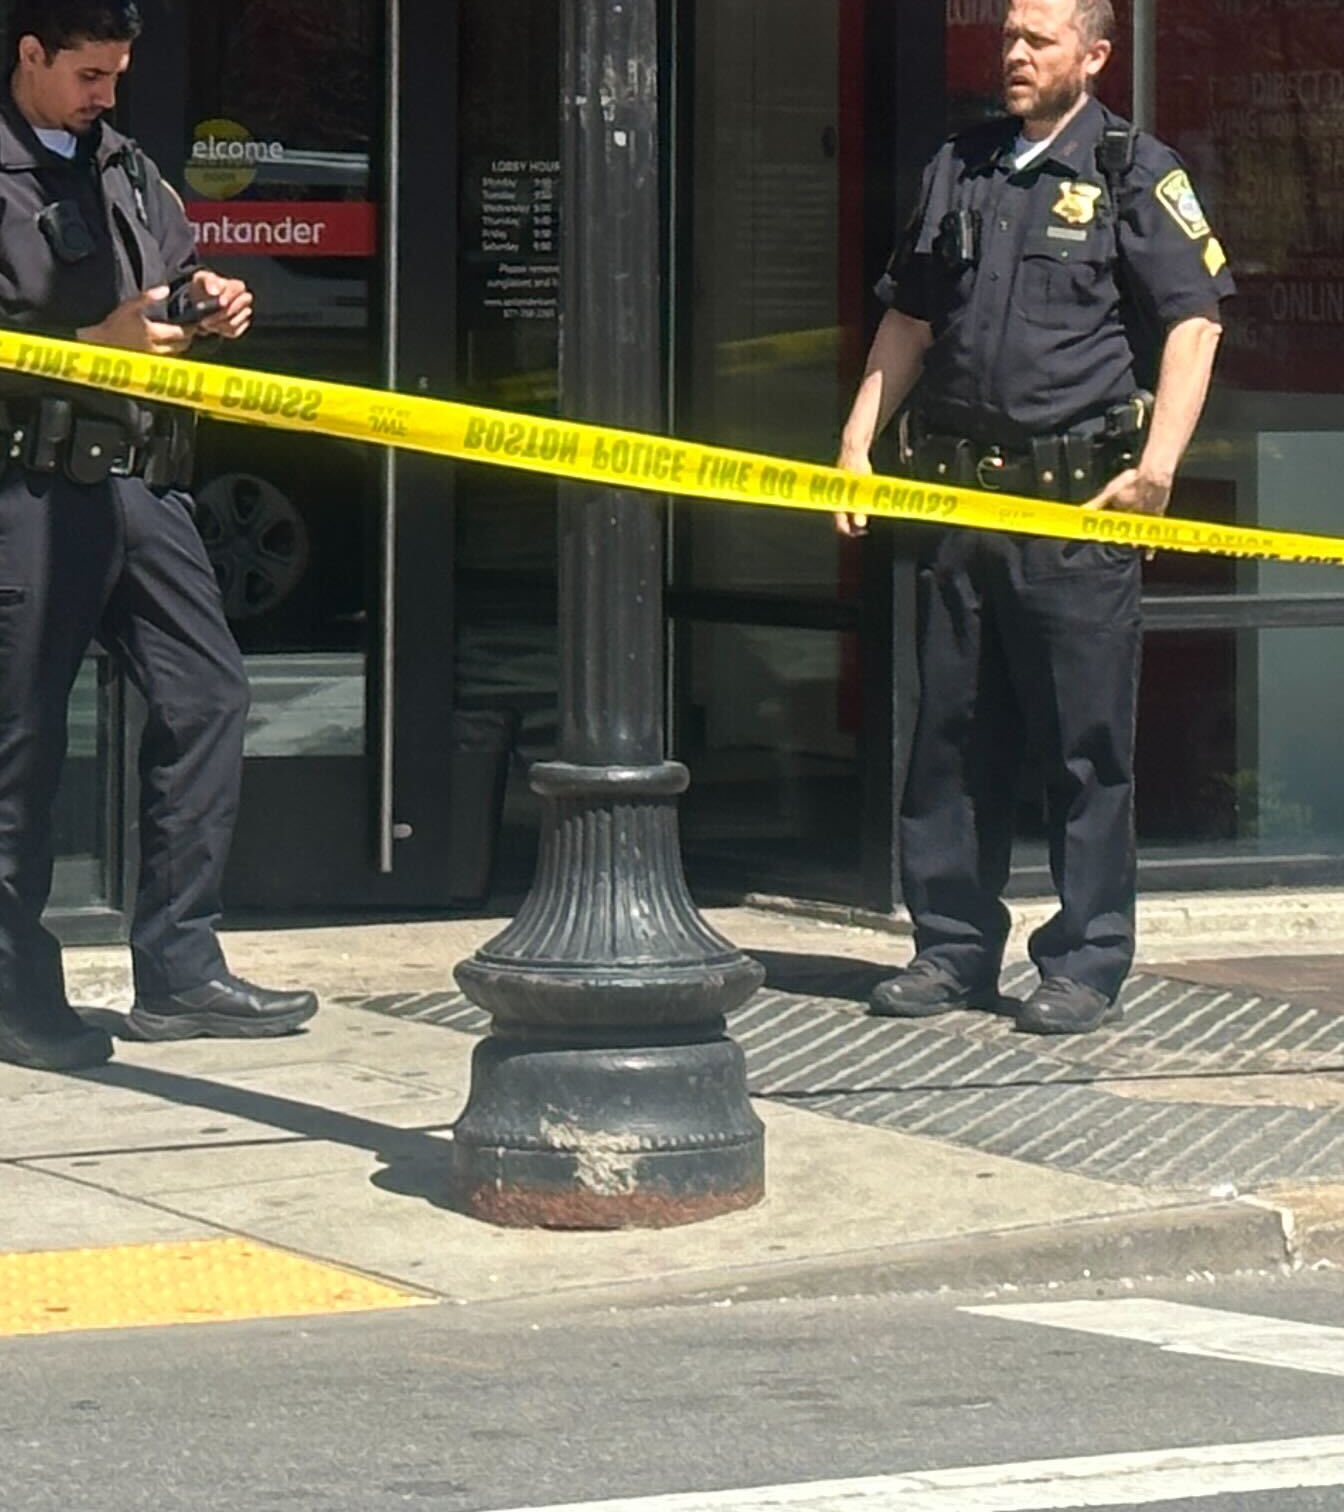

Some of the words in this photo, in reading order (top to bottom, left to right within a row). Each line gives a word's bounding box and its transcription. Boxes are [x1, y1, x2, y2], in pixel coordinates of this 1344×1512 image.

[191, 135, 284, 162] elcome
[530, 160, 560, 173] HOUR
[190, 216, 327, 246] antander
